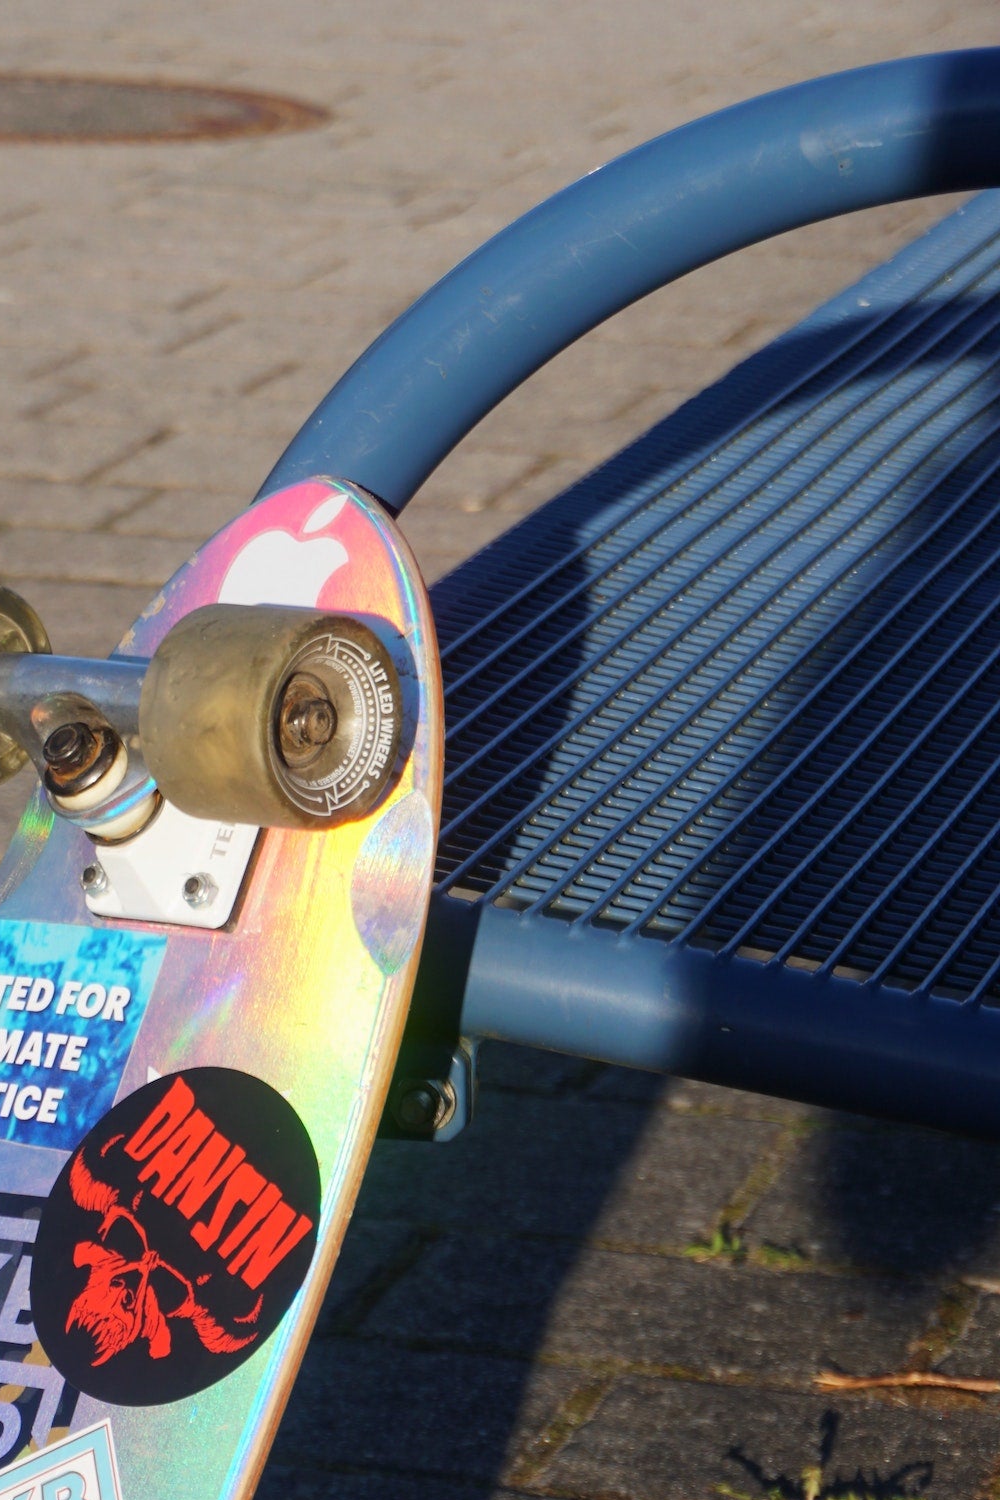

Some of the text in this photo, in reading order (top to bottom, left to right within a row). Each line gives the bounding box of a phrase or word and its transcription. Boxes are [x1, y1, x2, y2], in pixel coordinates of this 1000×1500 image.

[347, 681, 362, 715] POWERED
[367, 661, 394, 780] LIT LED WHEELS
[55, 981, 131, 1022] FOR
